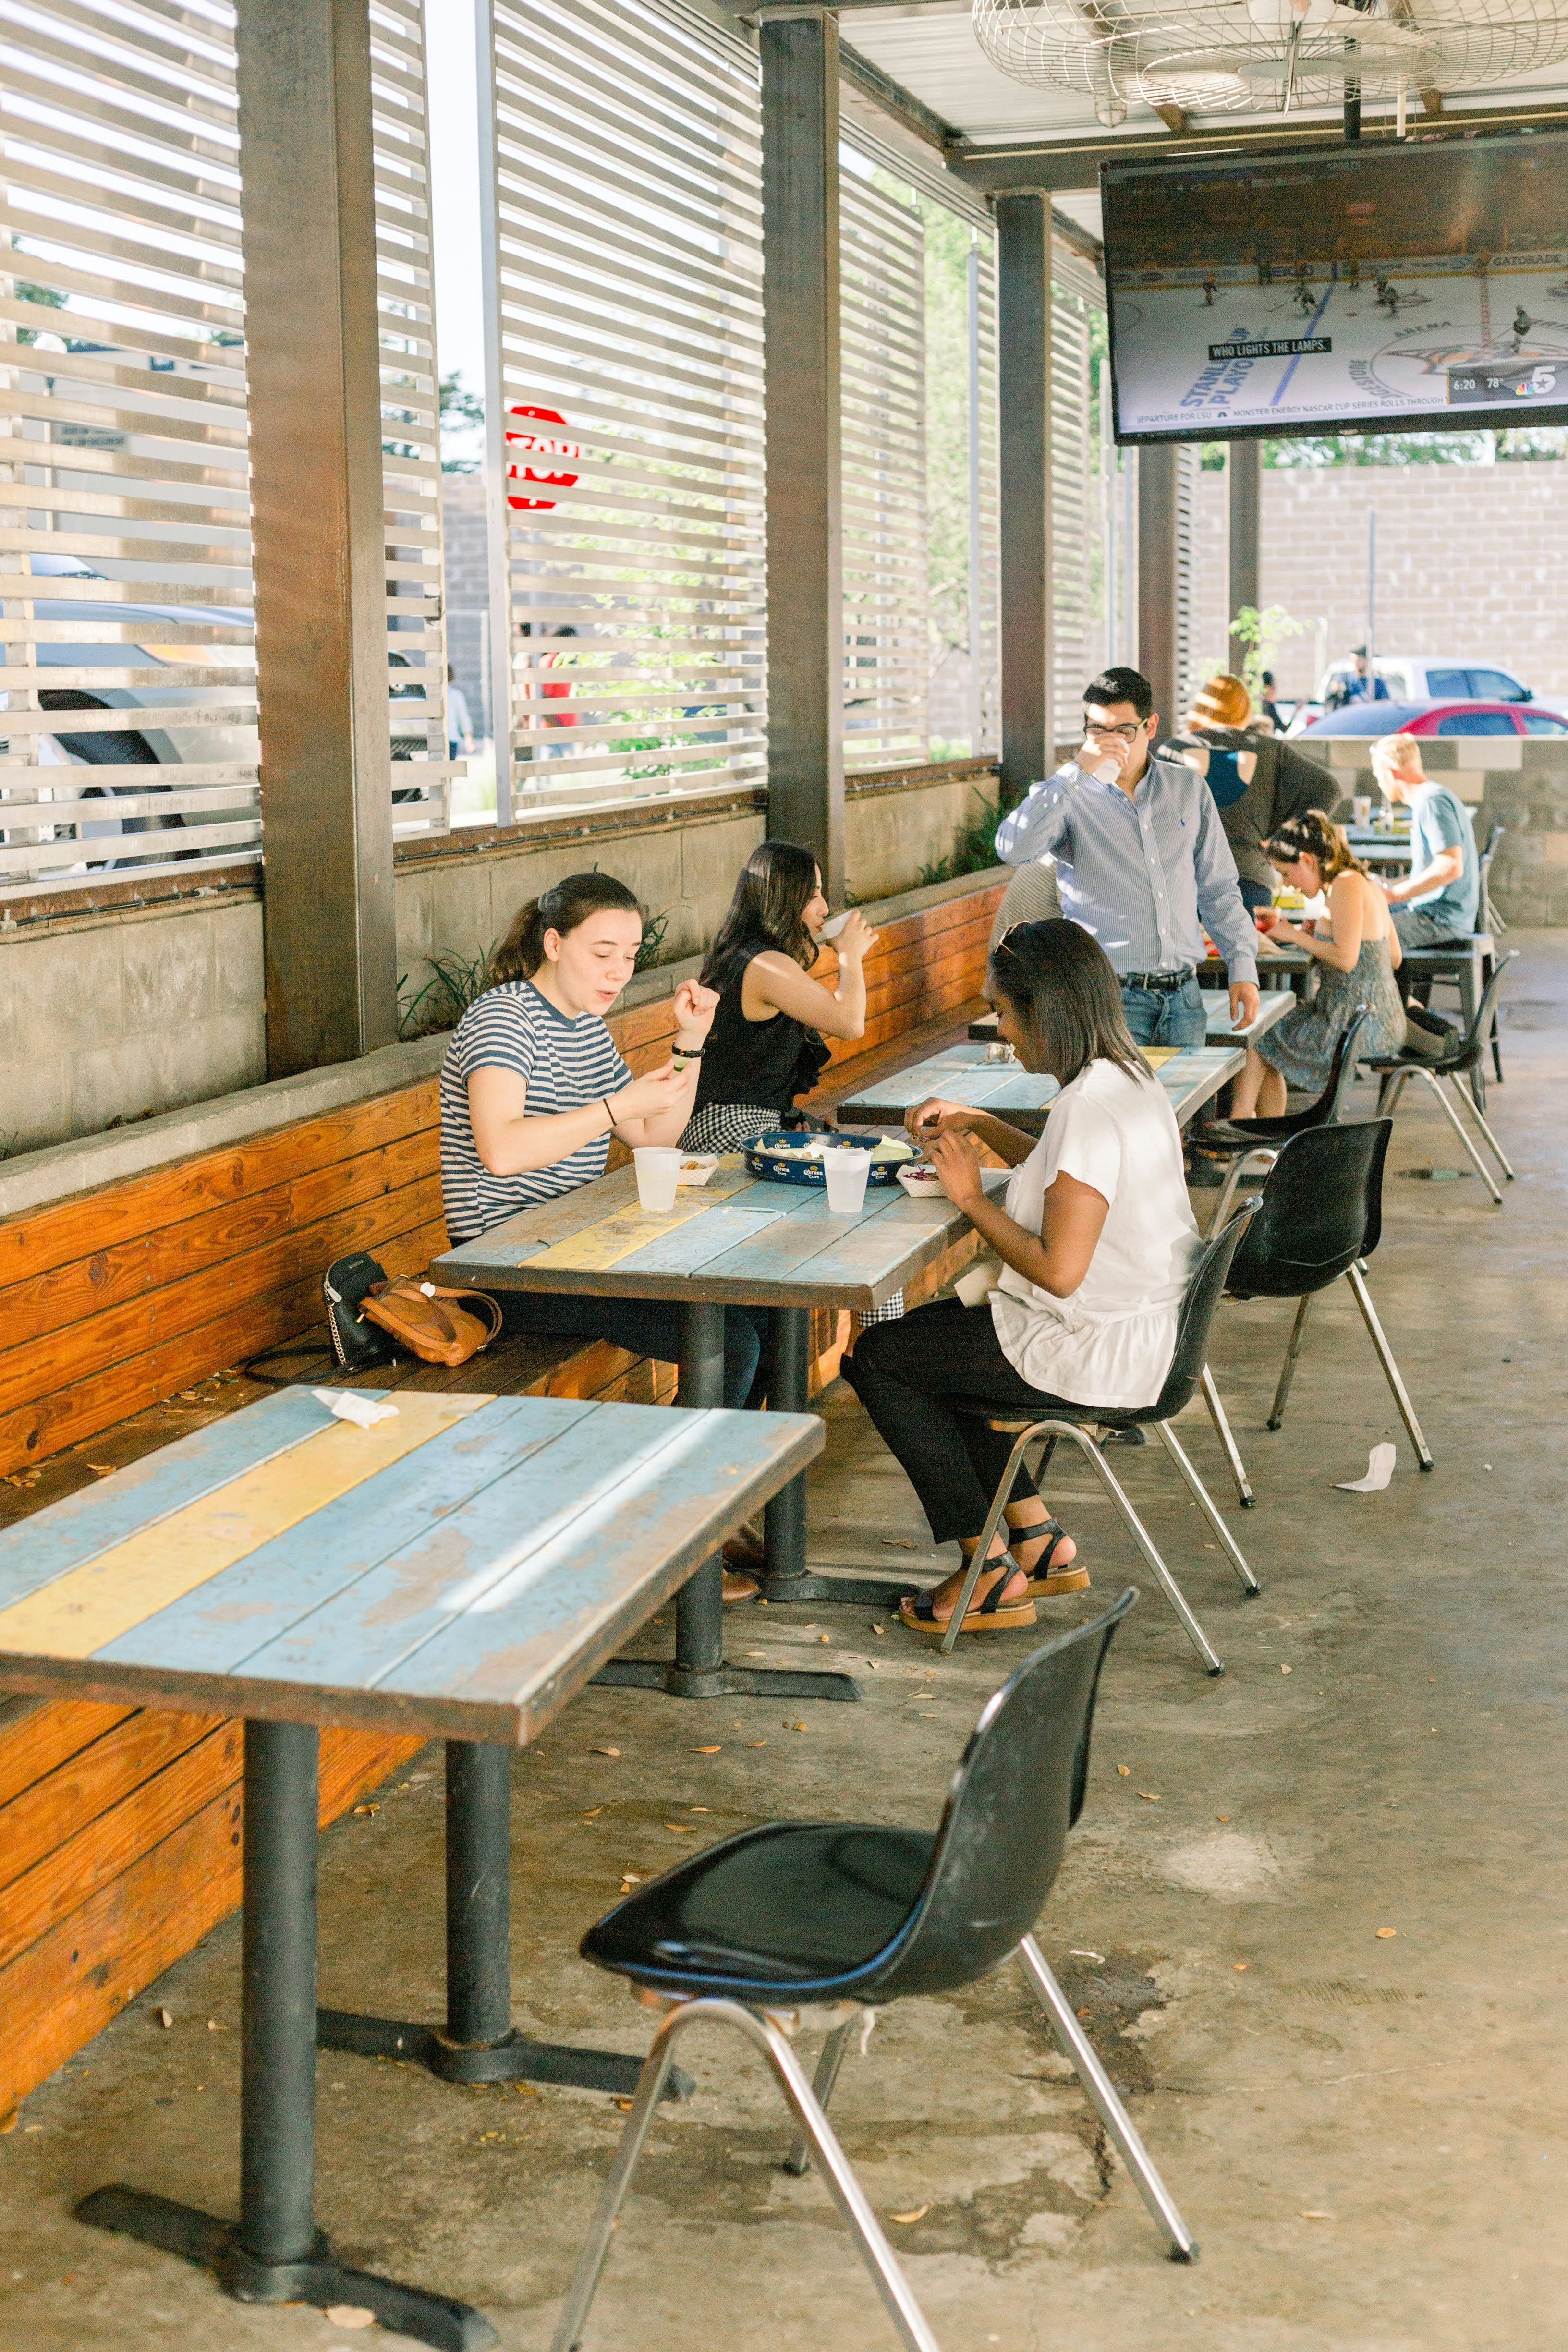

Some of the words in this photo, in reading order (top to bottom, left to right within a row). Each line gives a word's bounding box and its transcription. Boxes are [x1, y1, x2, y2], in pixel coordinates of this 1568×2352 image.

[1493, 254, 1562, 266] GATORADE
[1212, 346, 1235, 357] WHO
[1237, 344, 1269, 356] LIGHTS
[1272, 342, 1290, 353] THE
[1292, 339, 1327, 352] LAMPS.
[1179, 359, 1232, 407] STANL
[1453, 379, 1475, 390] 6:20
[1532, 365, 1556, 394] 5
[1233, 408, 1270, 417] MONSTER
[1272, 406, 1301, 415] ENERGY
[1303, 404, 1334, 413] NASCAR
[1352, 400, 1379, 409] SERIES
[1381, 399, 1405, 407] ROLLS
[1407, 397, 1443, 405] THROUGH
[506, 437, 576, 479] TOP
[773, 1165, 790, 1173] Corona
